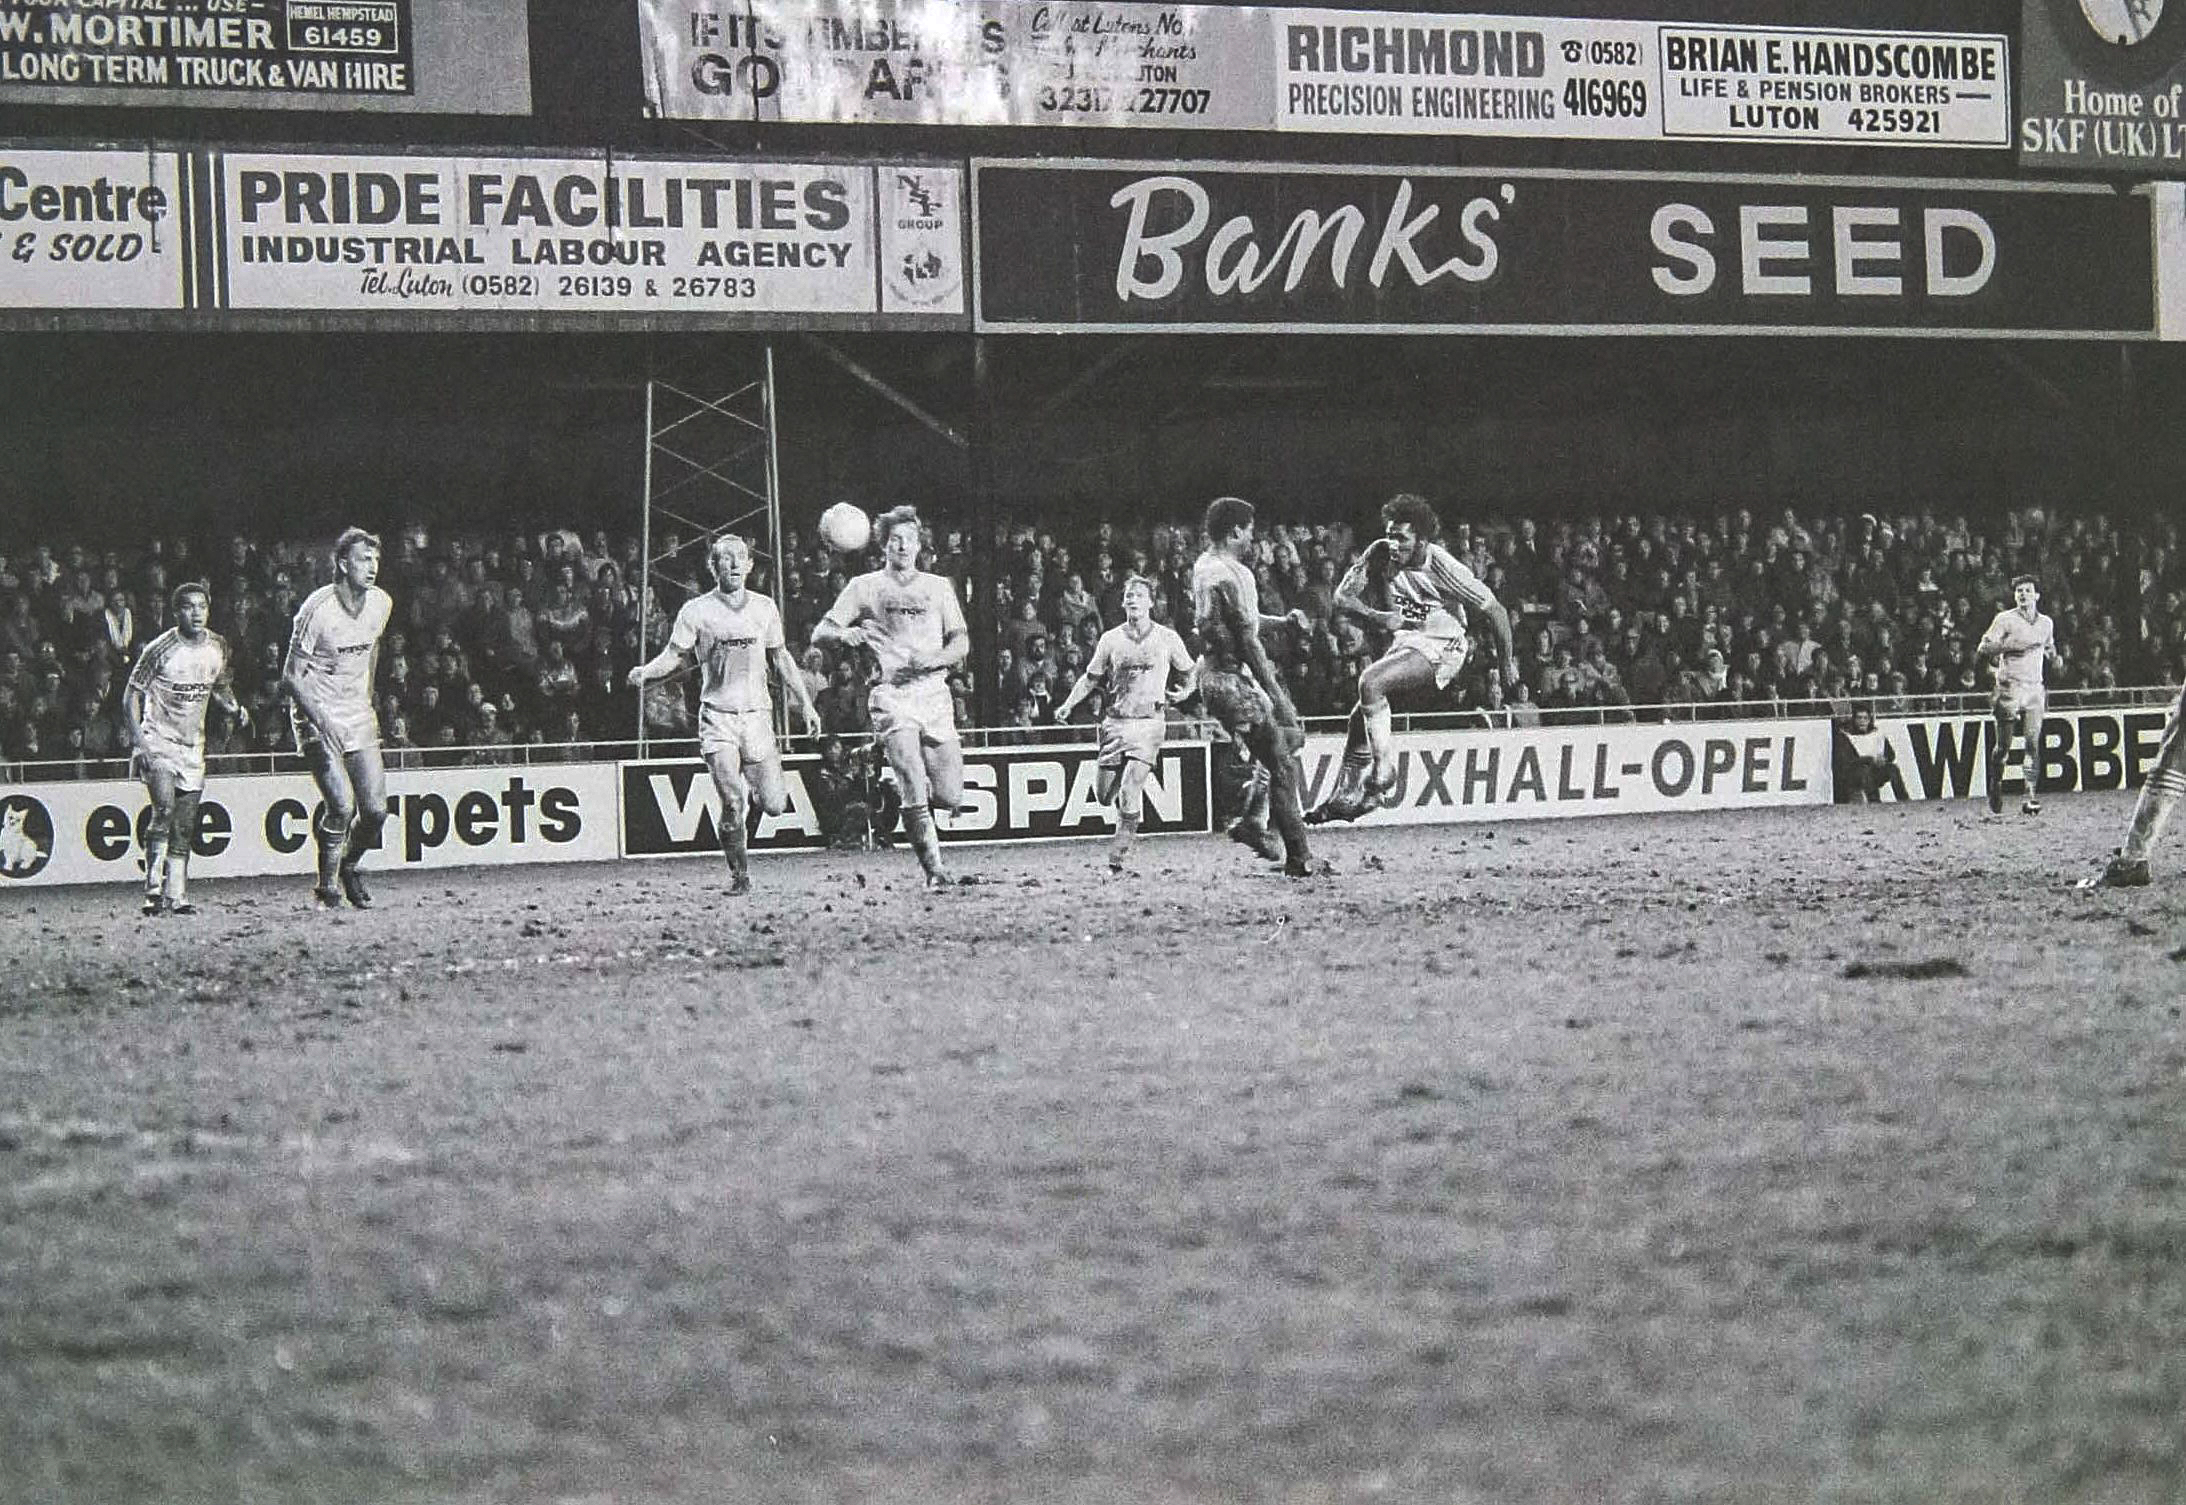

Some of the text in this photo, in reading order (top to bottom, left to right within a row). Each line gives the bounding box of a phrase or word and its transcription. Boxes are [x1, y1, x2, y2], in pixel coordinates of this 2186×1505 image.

[50, 13, 276, 49] MORTIMER
[289, 6, 393, 22] HEMEL HEMPSTEAD
[304, 27, 382, 47] 61459
[1287, 25, 1546, 78] RICHMOND
[1585, 40, 1644, 67] (0582)
[1666, 36, 1758, 74] BRIAN
[3, 51, 407, 91] LONG TERM TRUCK & VAN HIRE
[1139, 88, 1211, 114] 27707
[1288, 83, 1556, 120] PRECISION ENGINEERING
[1563, 77, 1647, 118] 416969
[1680, 77, 1950, 105] LIFE & PENSION BROKERS
[2064, 79, 2183, 118] Home of
[1729, 105, 1940, 134] LUTON 425921
[2021, 118, 2087, 153] SKF
[2094, 118, 2157, 159] (UK)
[0, 166, 168, 222] Centre
[240, 170, 441, 225] PRIDE
[468, 173, 851, 232] FACILITIES
[12, 232, 144, 264] & SOLD
[241, 235, 853, 269] INDUSTRIAL LABOUR AGENCY
[1650, 202, 1997, 297] SEED
[393, 266, 453, 299] Luton
[462, 274, 540, 297] (0582)
[558, 276, 632, 298] 26139
[644, 279, 658, 296] &
[672, 277, 757, 299] 26783
